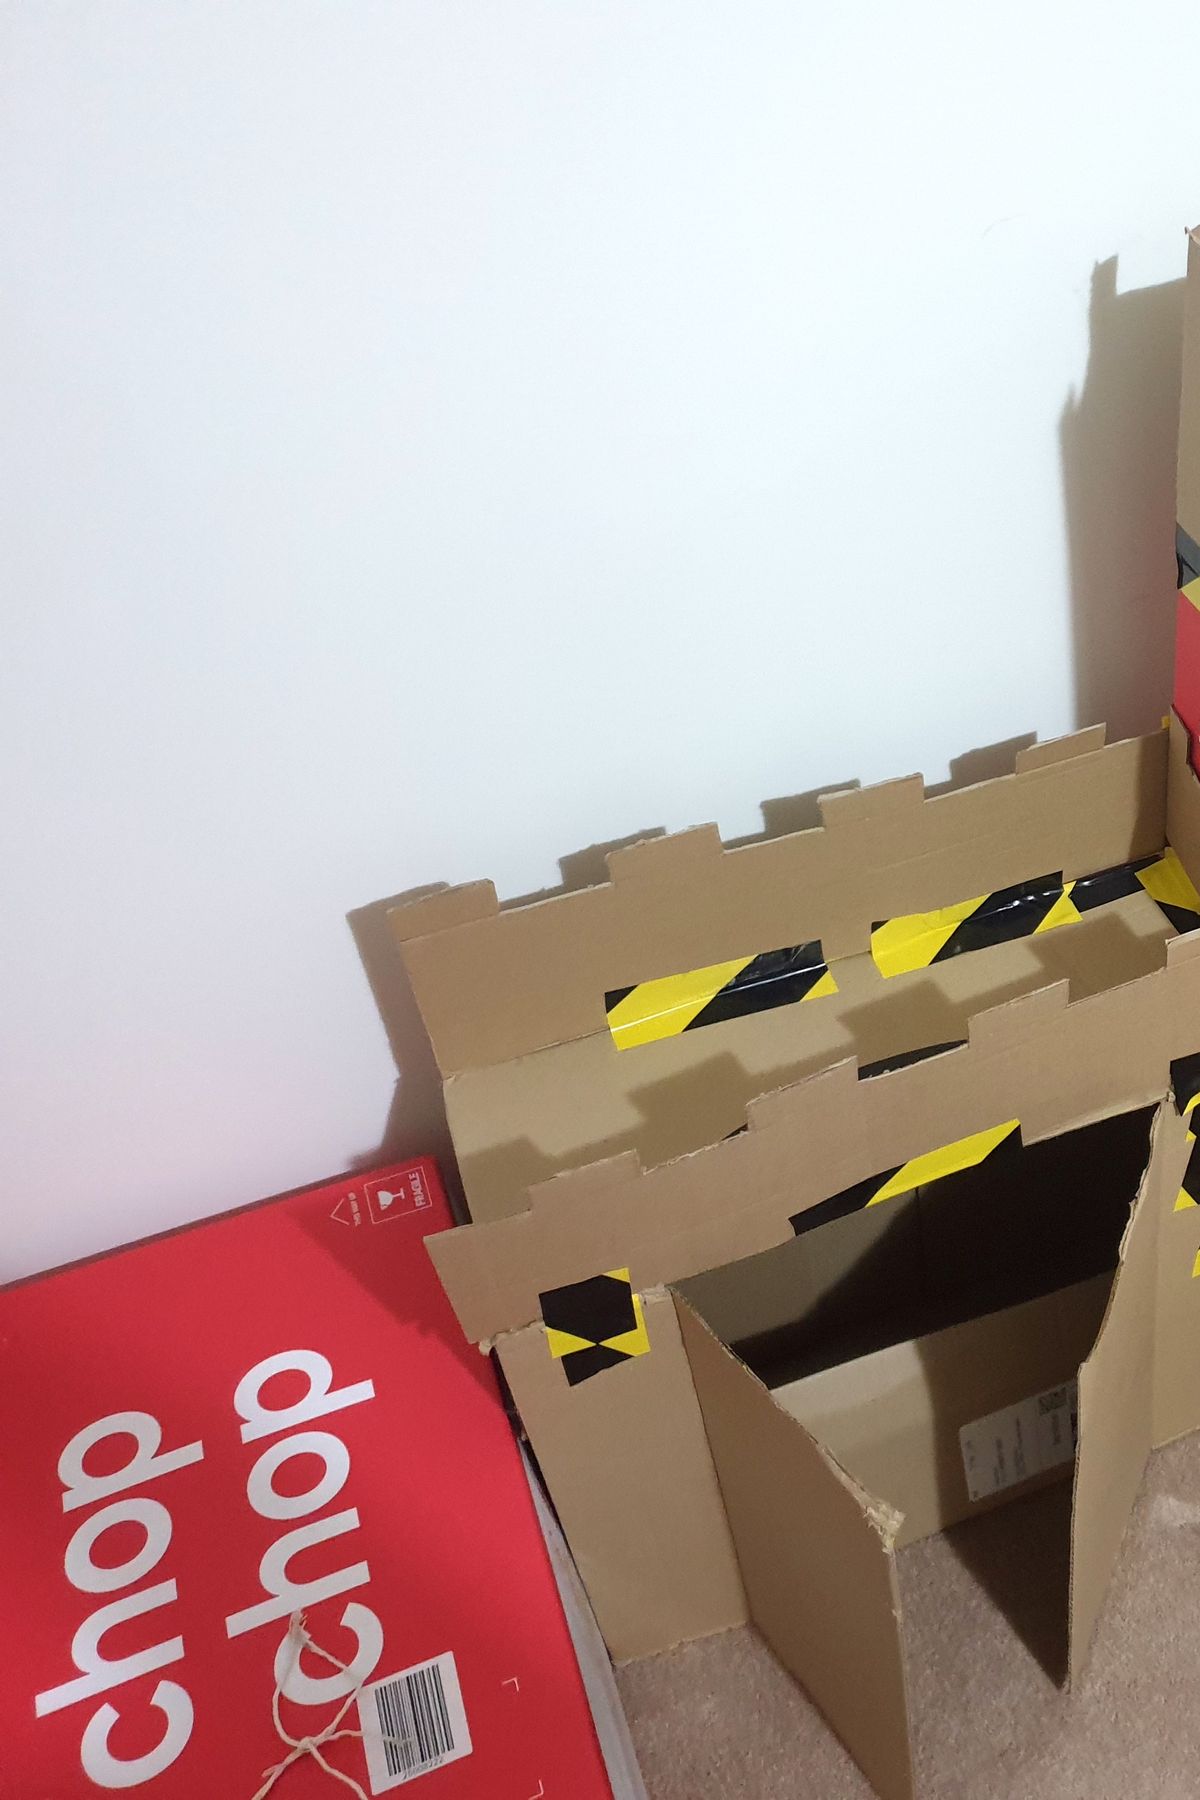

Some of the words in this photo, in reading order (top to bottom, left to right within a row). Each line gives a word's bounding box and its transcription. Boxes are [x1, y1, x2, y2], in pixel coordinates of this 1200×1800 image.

[408, 1172, 426, 1207] FRAGILE
[36, 1412, 203, 1788] chop
[226, 1350, 384, 1705] chop
